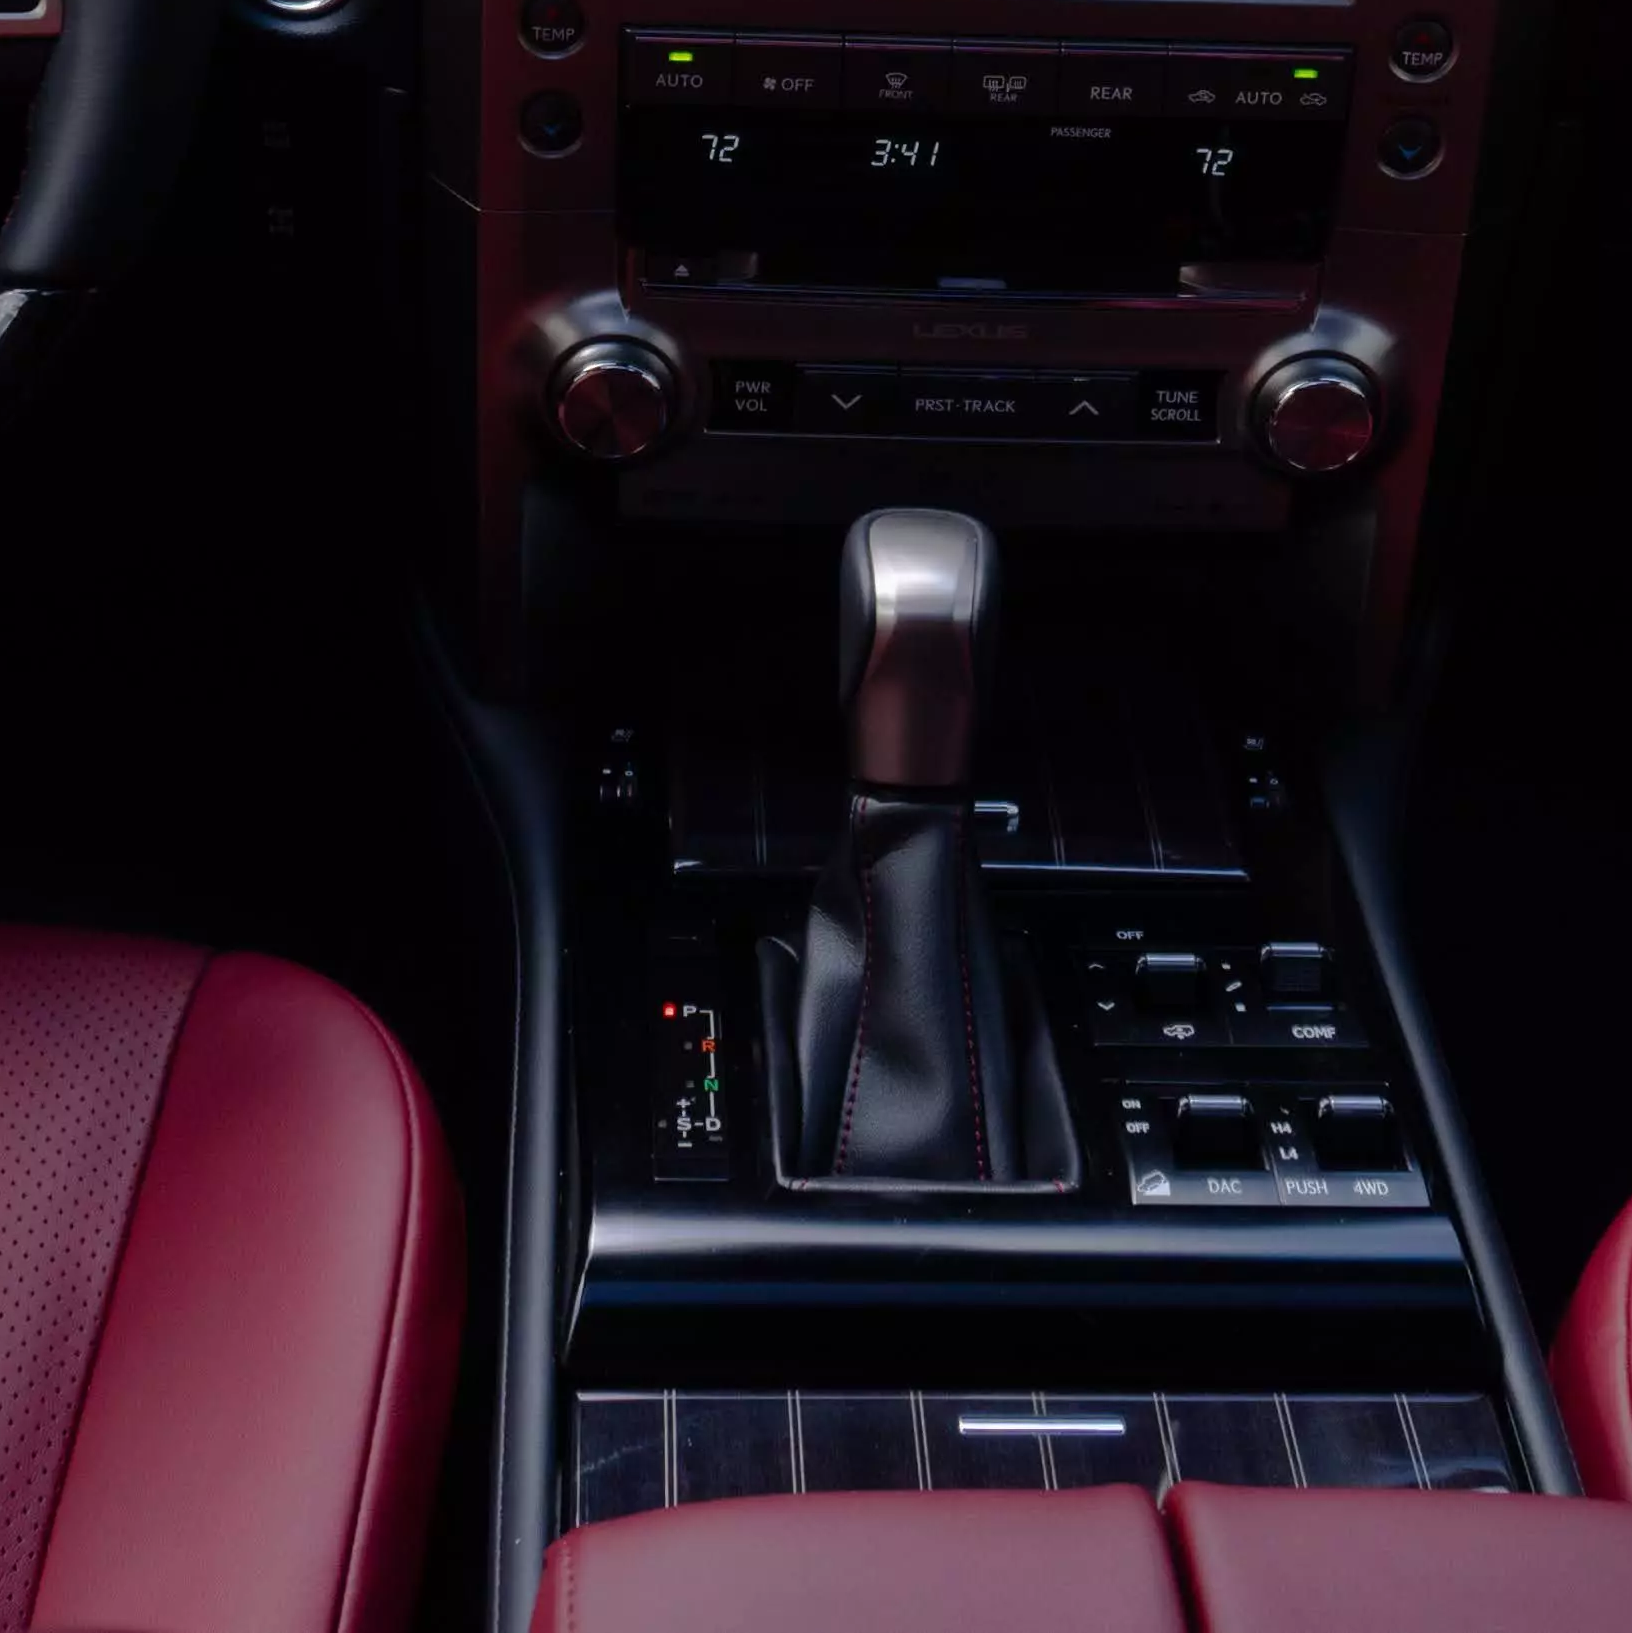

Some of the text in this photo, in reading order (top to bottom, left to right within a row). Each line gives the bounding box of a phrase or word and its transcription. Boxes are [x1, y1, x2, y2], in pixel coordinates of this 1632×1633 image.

[531, 26, 576, 42] TEMP
[1402, 51, 1443, 66] TEMP
[656, 74, 703, 88] AUTO
[781, 78, 813, 91] OFF
[878, 88, 914, 100] FRONT
[989, 92, 1018, 103] REAR
[1091, 87, 1132, 99] REAR
[1236, 92, 1282, 104] AUTO
[1051, 128, 1111, 138] PASSENGER
[702, 135, 739, 162] 72
[871, 140, 939, 166] 3:41
[1197, 149, 1233, 175] 72
[736, 381, 770, 393] PWR
[1157, 391, 1197, 403] TUNE
[735, 399, 767, 411] VOL
[1151, 409, 1200, 421] SCROLL
[1117, 931, 1143, 939] OFF
[682, 1004, 698, 1018] P
[1292, 1026, 1335, 1038] COMF
[701, 1039, 716, 1053] R
[703, 1078, 720, 1092] N
[1122, 1100, 1141, 1109] ON
[676, 1117, 722, 1132] S D
[1126, 1122, 1149, 1133] OFF
[1271, 1122, 1292, 1133] H4
[1280, 1148, 1298, 1159] L4
[1208, 1180, 1241, 1193] DAC
[1286, 1181, 1388, 1195] PUSH 4WD
